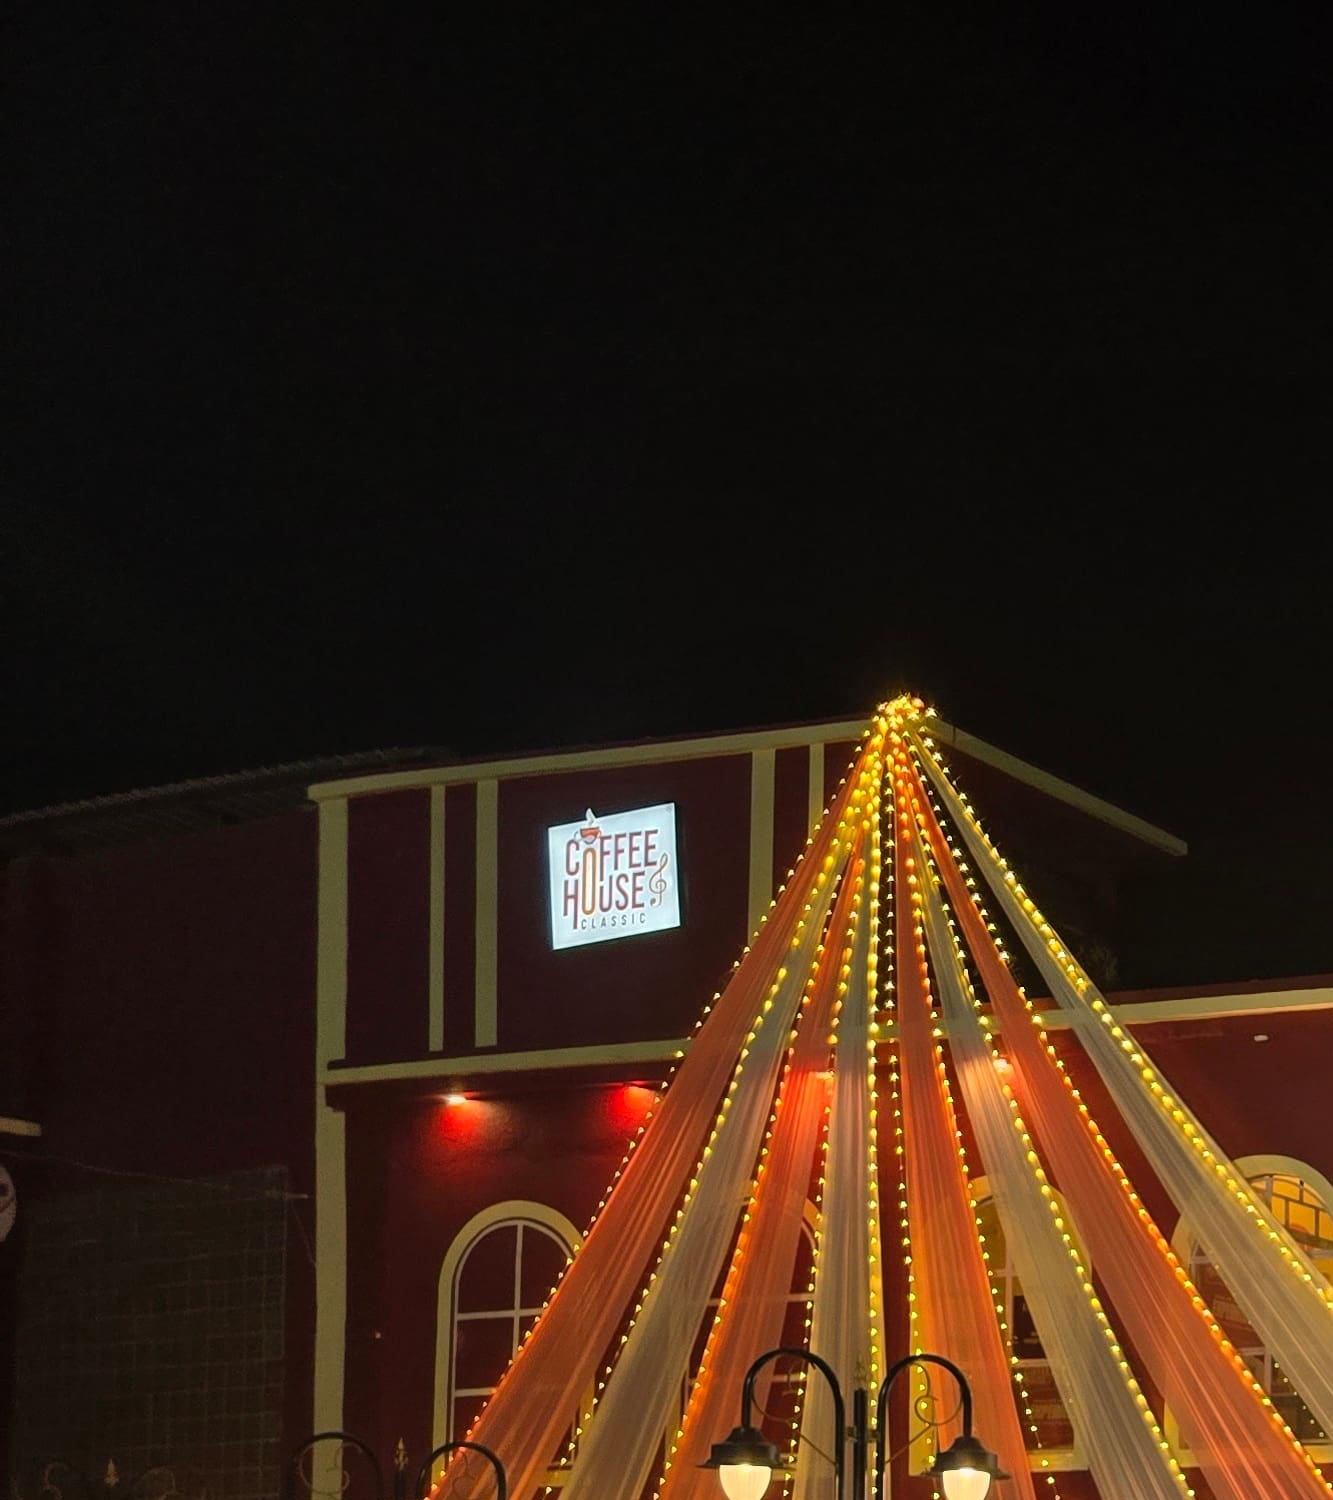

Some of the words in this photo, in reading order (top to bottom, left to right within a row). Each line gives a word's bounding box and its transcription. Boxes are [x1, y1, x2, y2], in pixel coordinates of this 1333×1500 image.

[565, 829, 659, 883] COFFEE
[563, 870, 646, 930] HOUSE
[581, 912, 647, 930] CLASSIC
